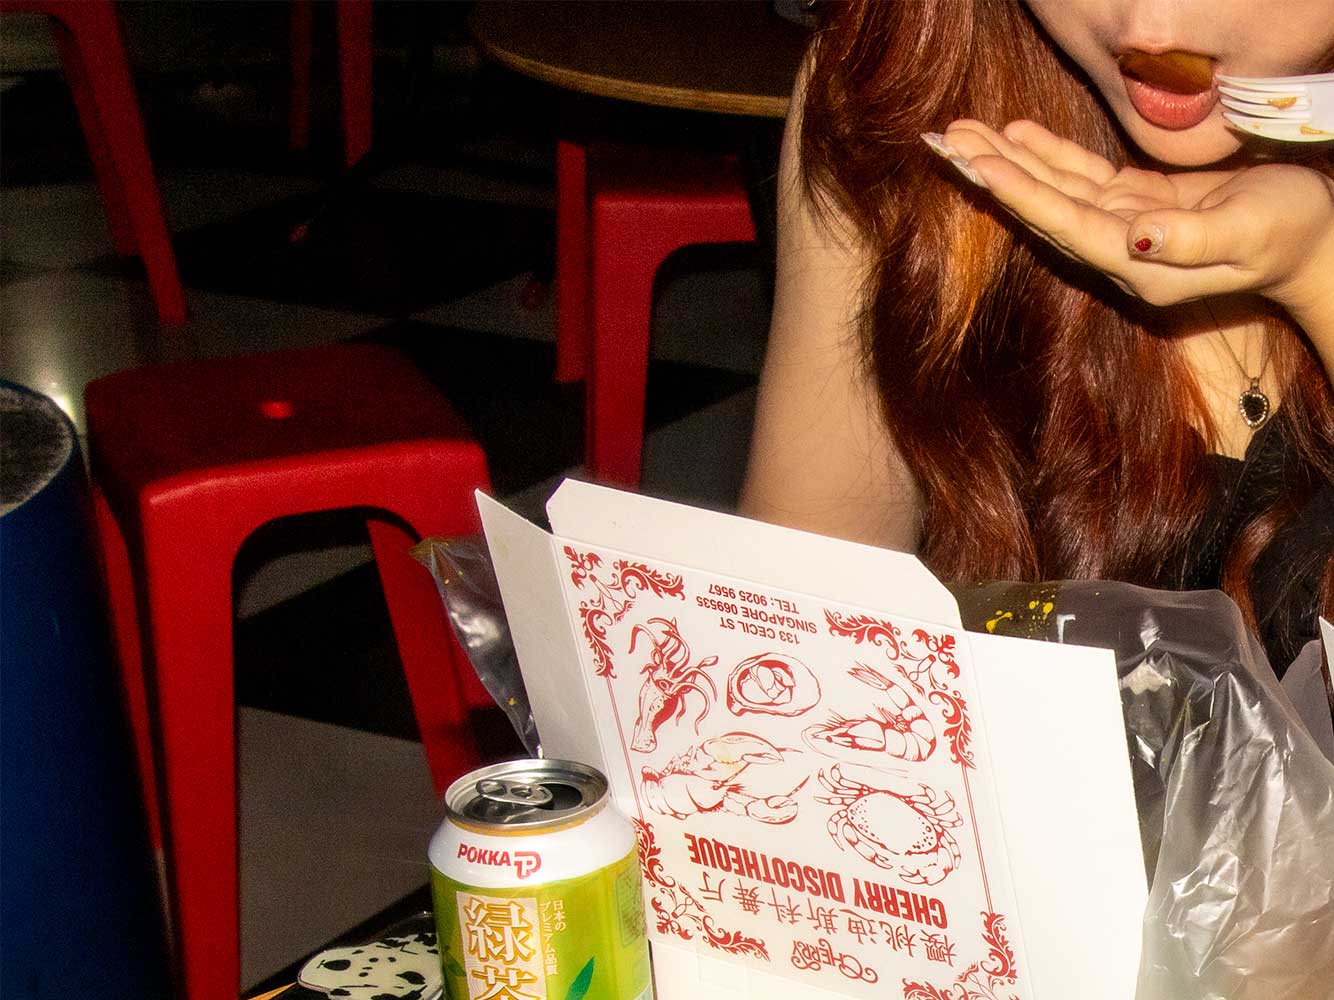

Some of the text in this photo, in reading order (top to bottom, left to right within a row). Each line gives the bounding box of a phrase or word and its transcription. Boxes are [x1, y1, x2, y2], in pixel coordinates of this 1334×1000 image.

[696, 596, 817, 633] SINGAPORE 069535
[708, 583, 799, 613] TEL: 9025 9567
[719, 617, 800, 644] 133 CECIL ST
[457, 843, 512, 867] POKKA
[684, 832, 949, 930] CHERRY DISCOTHEQUE
[698, 871, 958, 968] 樱桃迪斯科舞厅
[790, 937, 879, 984] CHERRY
